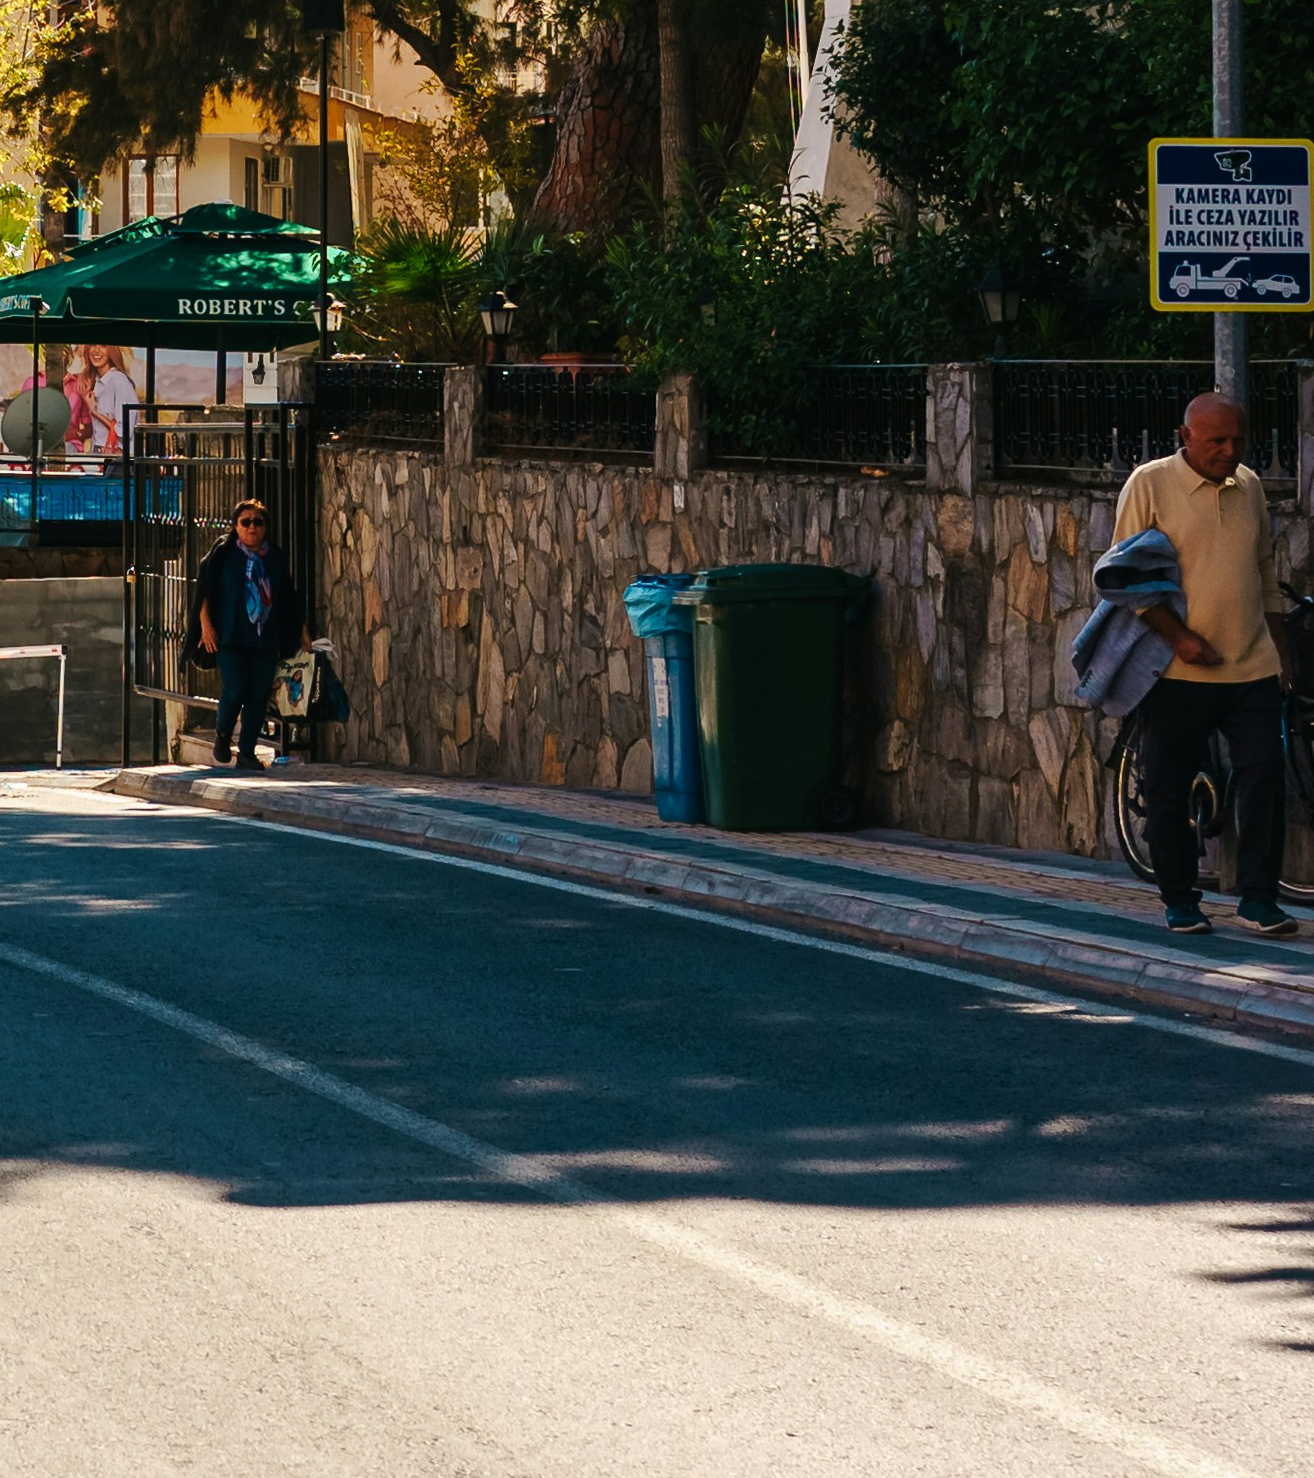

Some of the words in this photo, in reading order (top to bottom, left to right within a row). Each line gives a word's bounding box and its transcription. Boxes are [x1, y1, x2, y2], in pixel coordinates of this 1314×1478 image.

[1175, 188, 1241, 204] KAMERA
[1245, 188, 1292, 205] KAYDI
[1169, 205, 1192, 225] İLE
[1197, 209, 1234, 225] CEZA
[1238, 210, 1299, 226] YAZILIR
[1164, 230, 1239, 246] ARACINIZ
[1243, 228, 1304, 251] ÇEKİLİR
